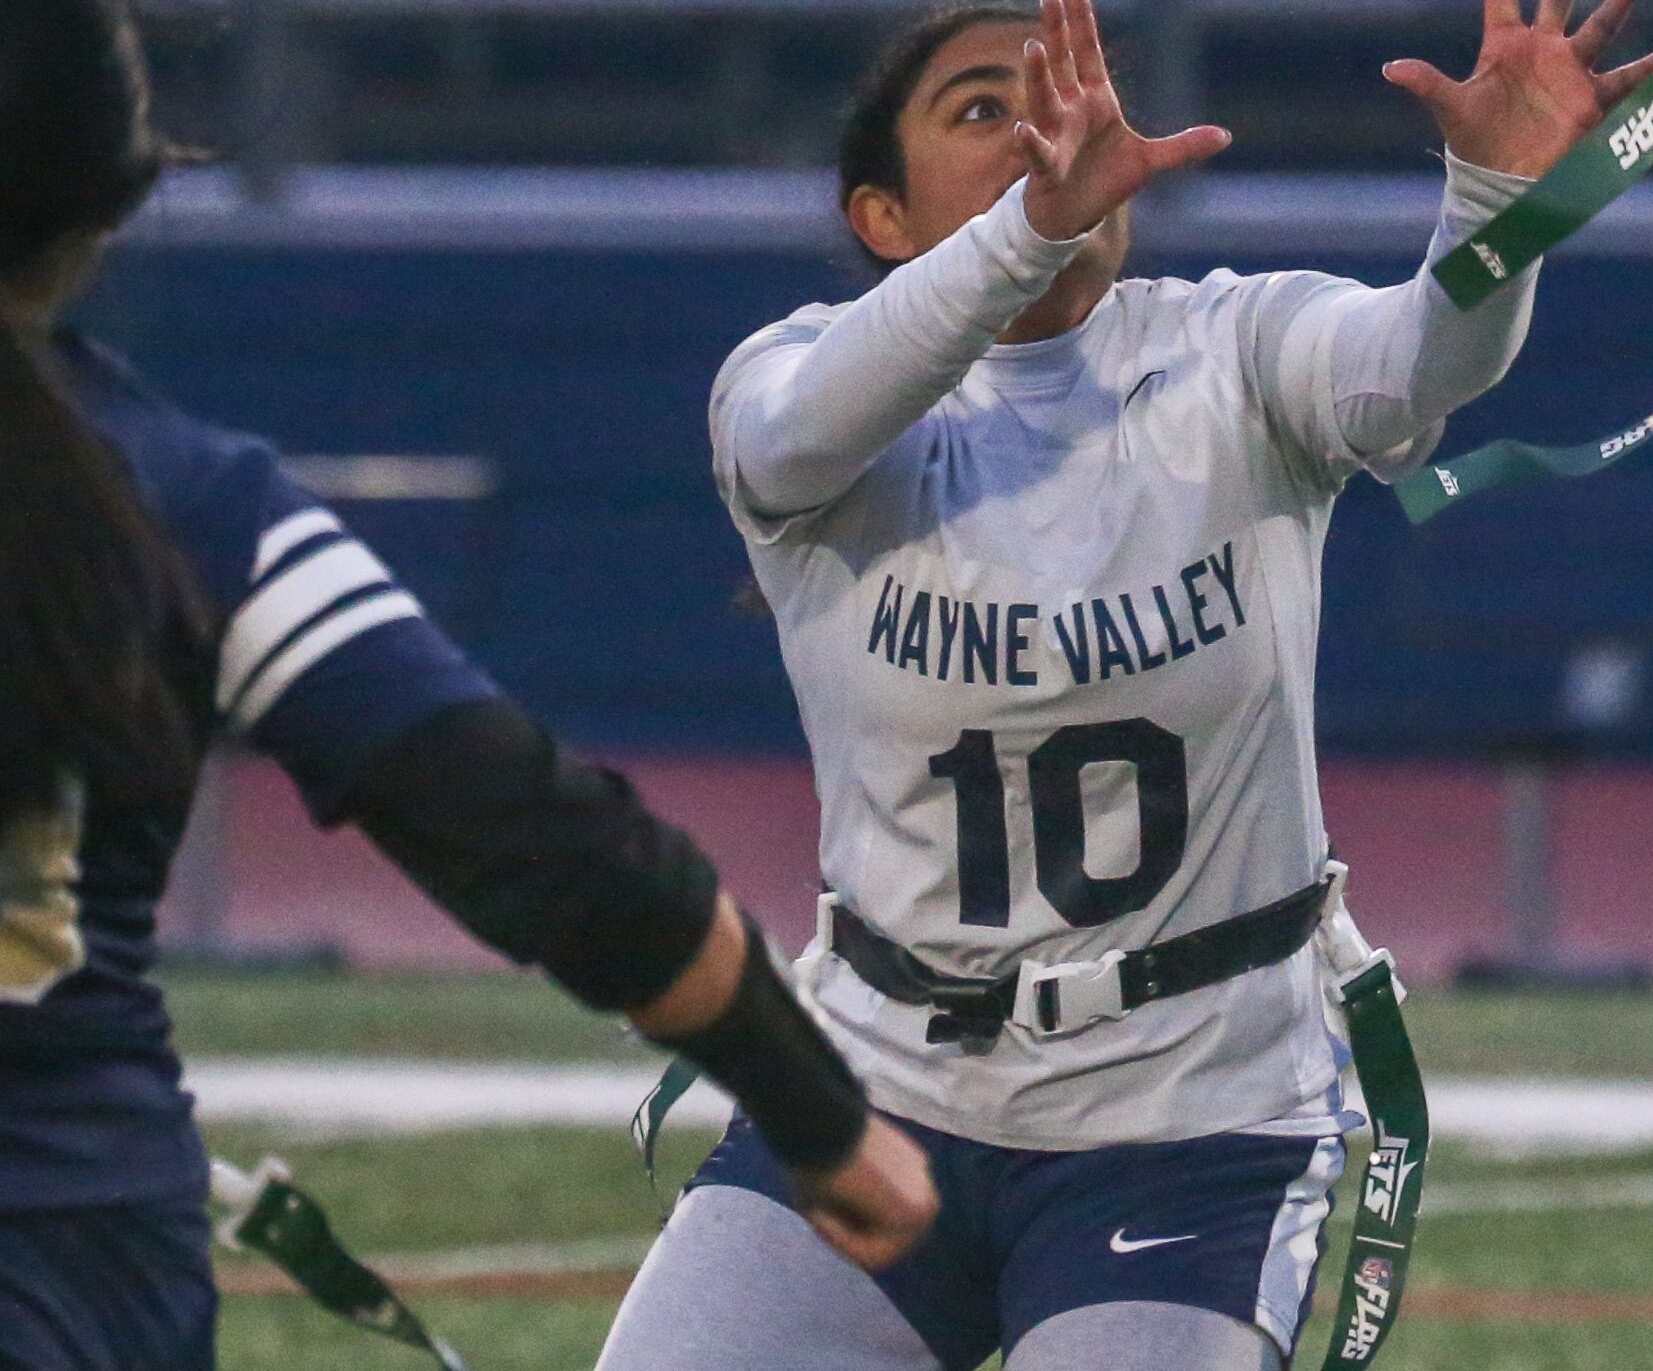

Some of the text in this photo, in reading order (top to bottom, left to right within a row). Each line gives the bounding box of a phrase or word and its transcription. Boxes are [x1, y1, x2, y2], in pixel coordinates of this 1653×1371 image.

[868, 542, 1247, 686] WAYNE VALLEY
[928, 717, 1190, 928] 10
[1363, 1119, 1418, 1226] JETS
[1341, 1275, 1391, 1360] FLAG
